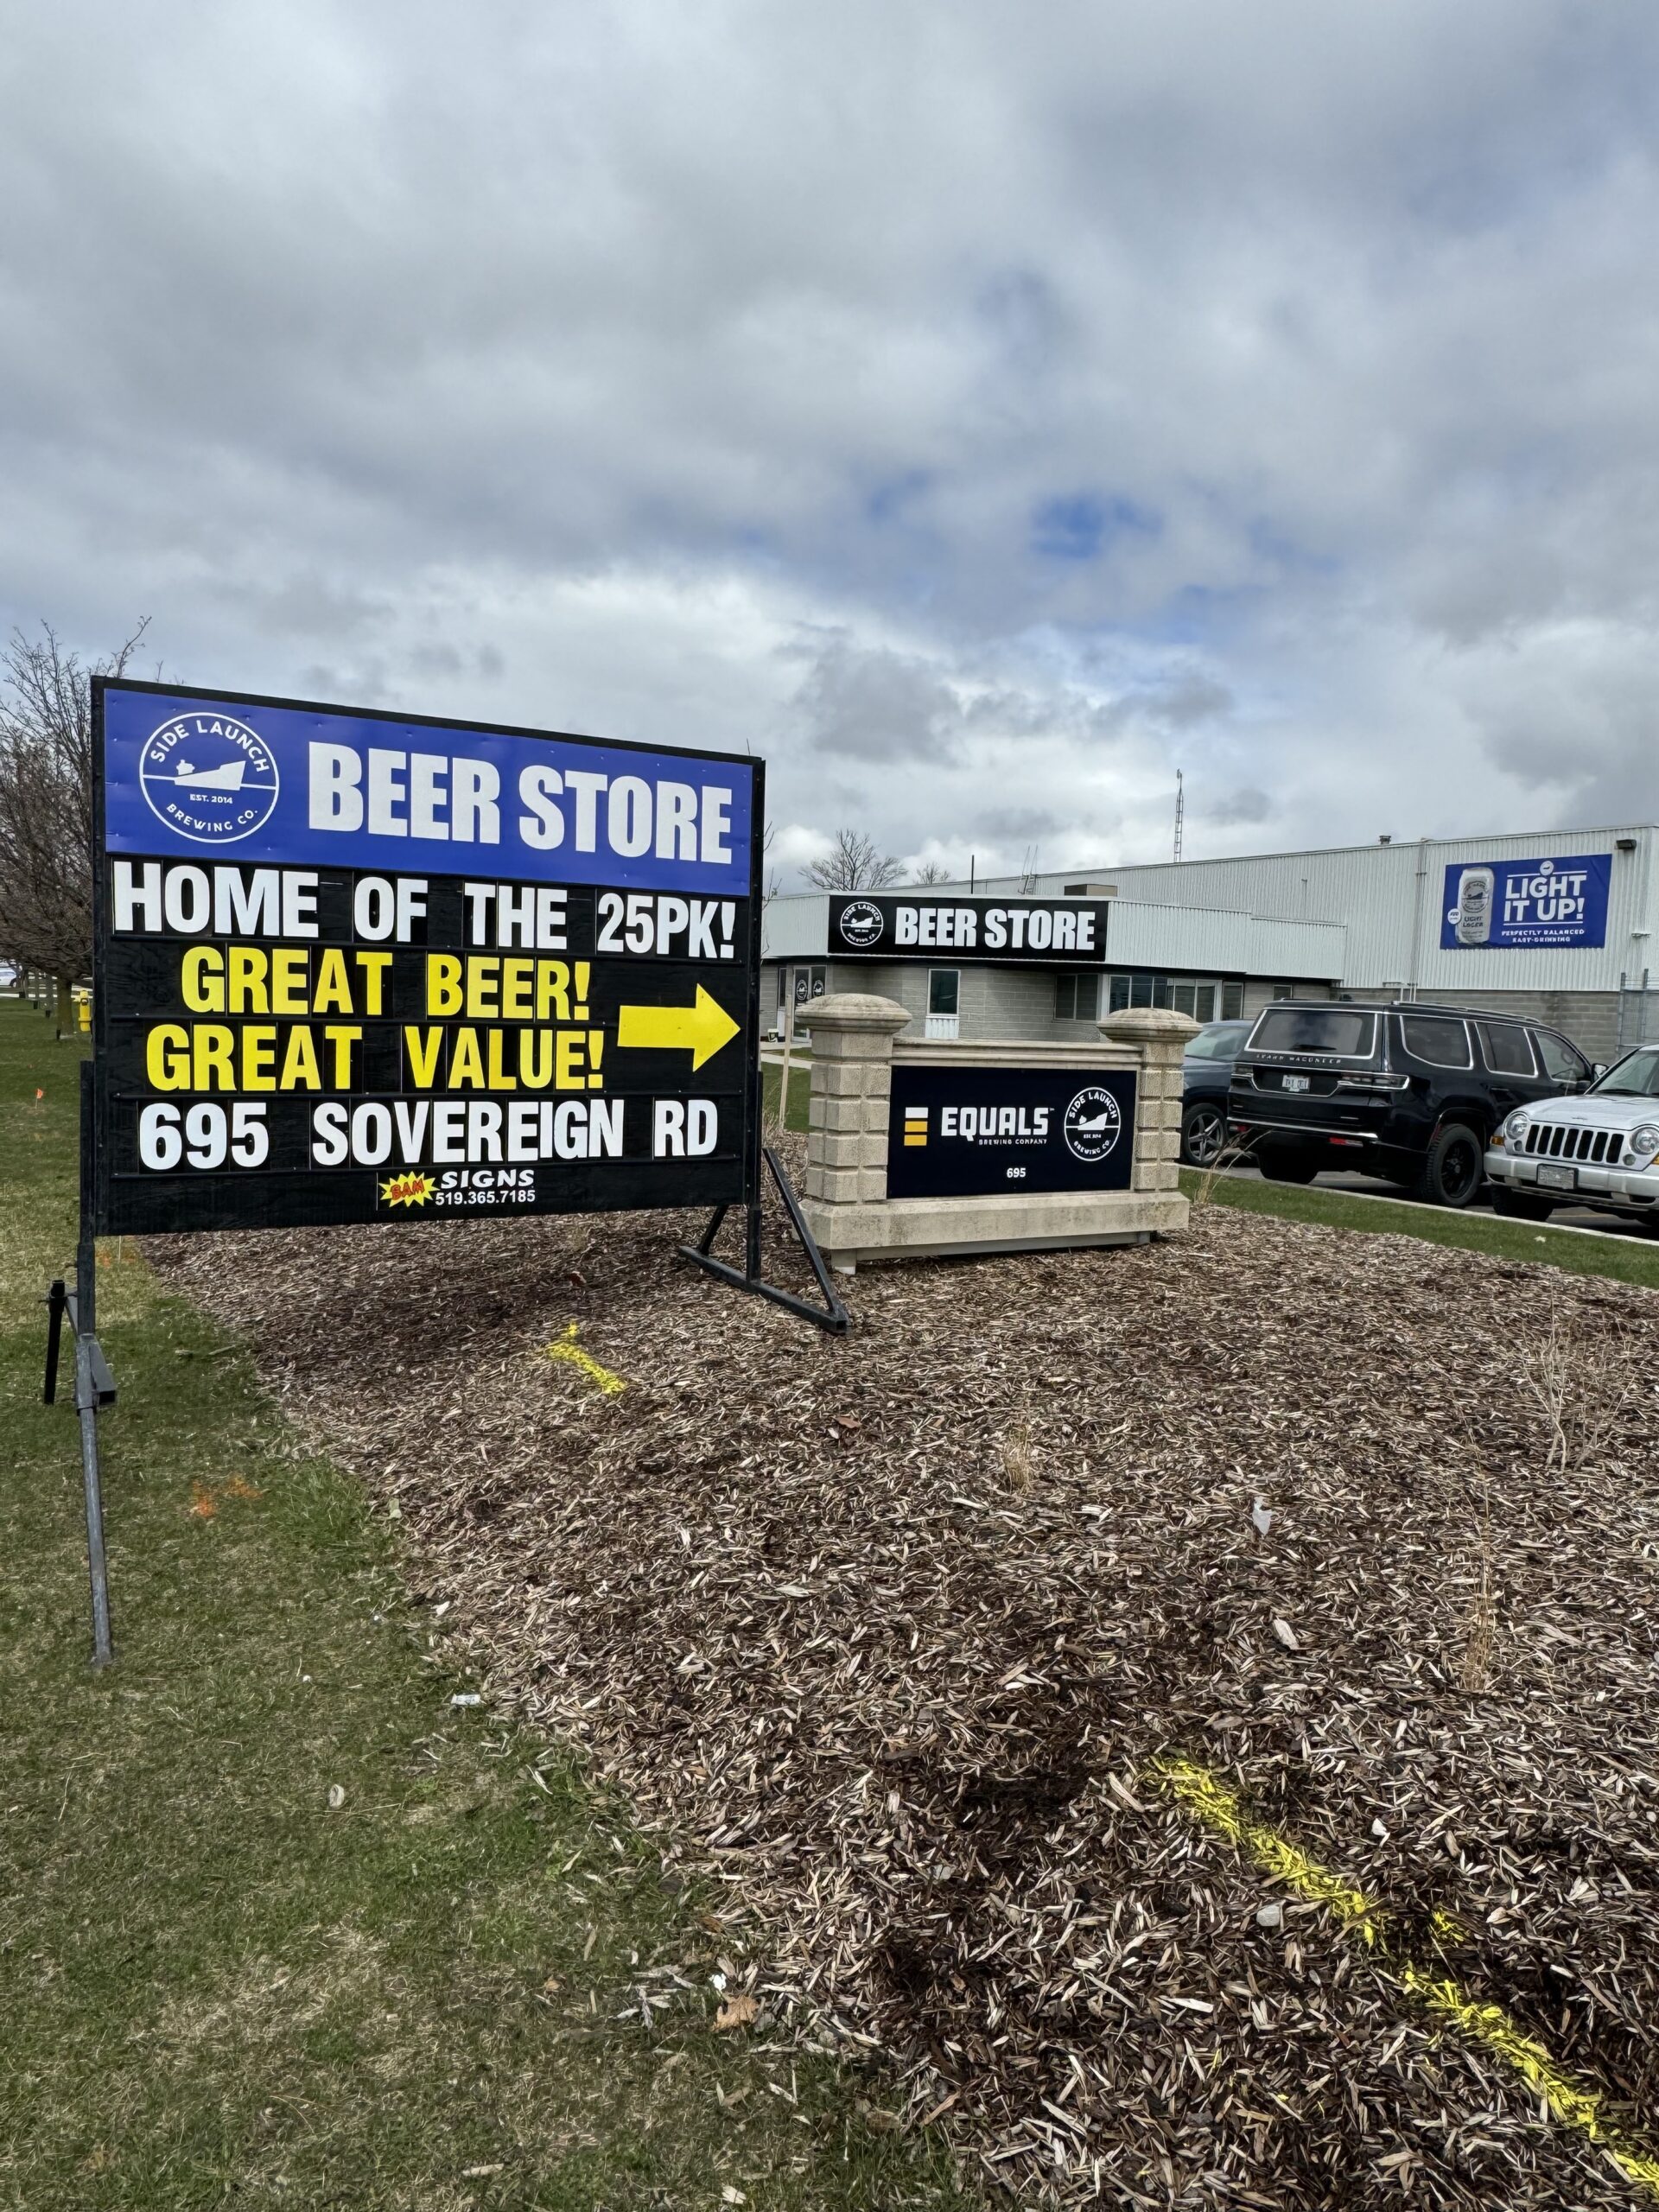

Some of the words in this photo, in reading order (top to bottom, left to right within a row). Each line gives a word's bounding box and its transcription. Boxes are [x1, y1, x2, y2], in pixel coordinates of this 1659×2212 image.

[150, 724, 189, 762] SIDE
[196, 720, 270, 772] LAUNCH
[166, 804, 233, 832] BREWING
[238, 810, 257, 824] CO.
[308, 741, 500, 845] BEER
[518, 765, 733, 865] STORE
[1505, 874, 1586, 899] LIGHT
[112, 861, 320, 938] HOME
[353, 876, 428, 942] OF
[464, 883, 568, 950] THE
[596, 893, 736, 959] 25PK!
[1503, 900, 1529, 921] IT
[1537, 898, 1585, 921] UP!
[895, 906, 976, 947] BEER
[985, 909, 1096, 950] STORE
[181, 945, 393, 1016] GREAT
[426, 953, 591, 1021] BEER!
[146, 1024, 363, 1092] GREAT
[404, 1026, 604, 1090] VALUE!
[1069, 1096, 1085, 1118] SIDE
[1089, 1091, 1118, 1118] LAUNCH
[138, 1103, 269, 1170] 695
[312, 1099, 624, 1166] SOVEREIGN
[654, 1100, 718, 1157] RD
[941, 1107, 1049, 1141] EQUALS
[441, 1169, 534, 1189] SIGNS
[1007, 1168, 1027, 1178] 695
[391, 1179, 425, 1200] BAM
[435, 1190, 536, 1206] 519.365.7185
